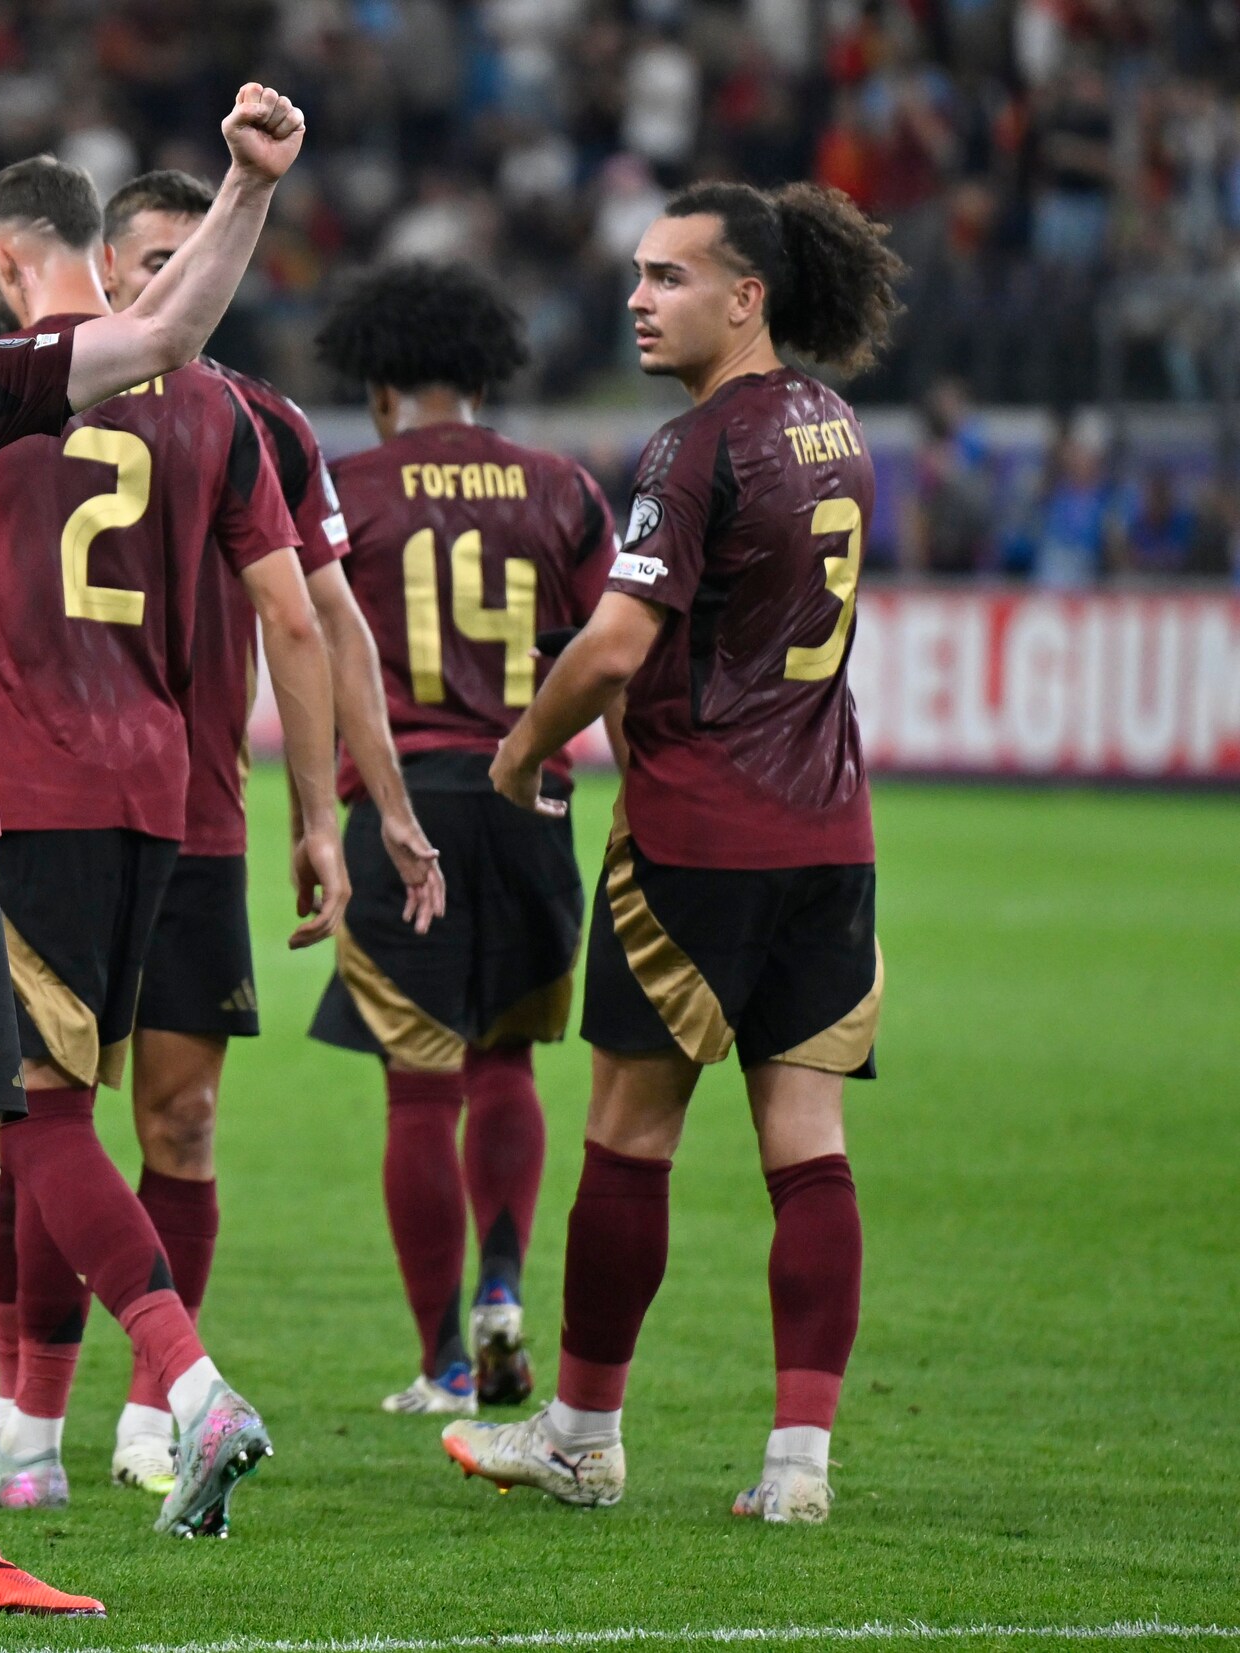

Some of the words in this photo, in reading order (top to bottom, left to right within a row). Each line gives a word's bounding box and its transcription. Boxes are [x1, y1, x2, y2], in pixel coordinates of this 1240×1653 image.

[61, 426, 152, 626] 2
[401, 462, 527, 500] FOFANA
[784, 418, 860, 465] THEATE
[403, 528, 537, 707] 14
[783, 497, 861, 681] 3
